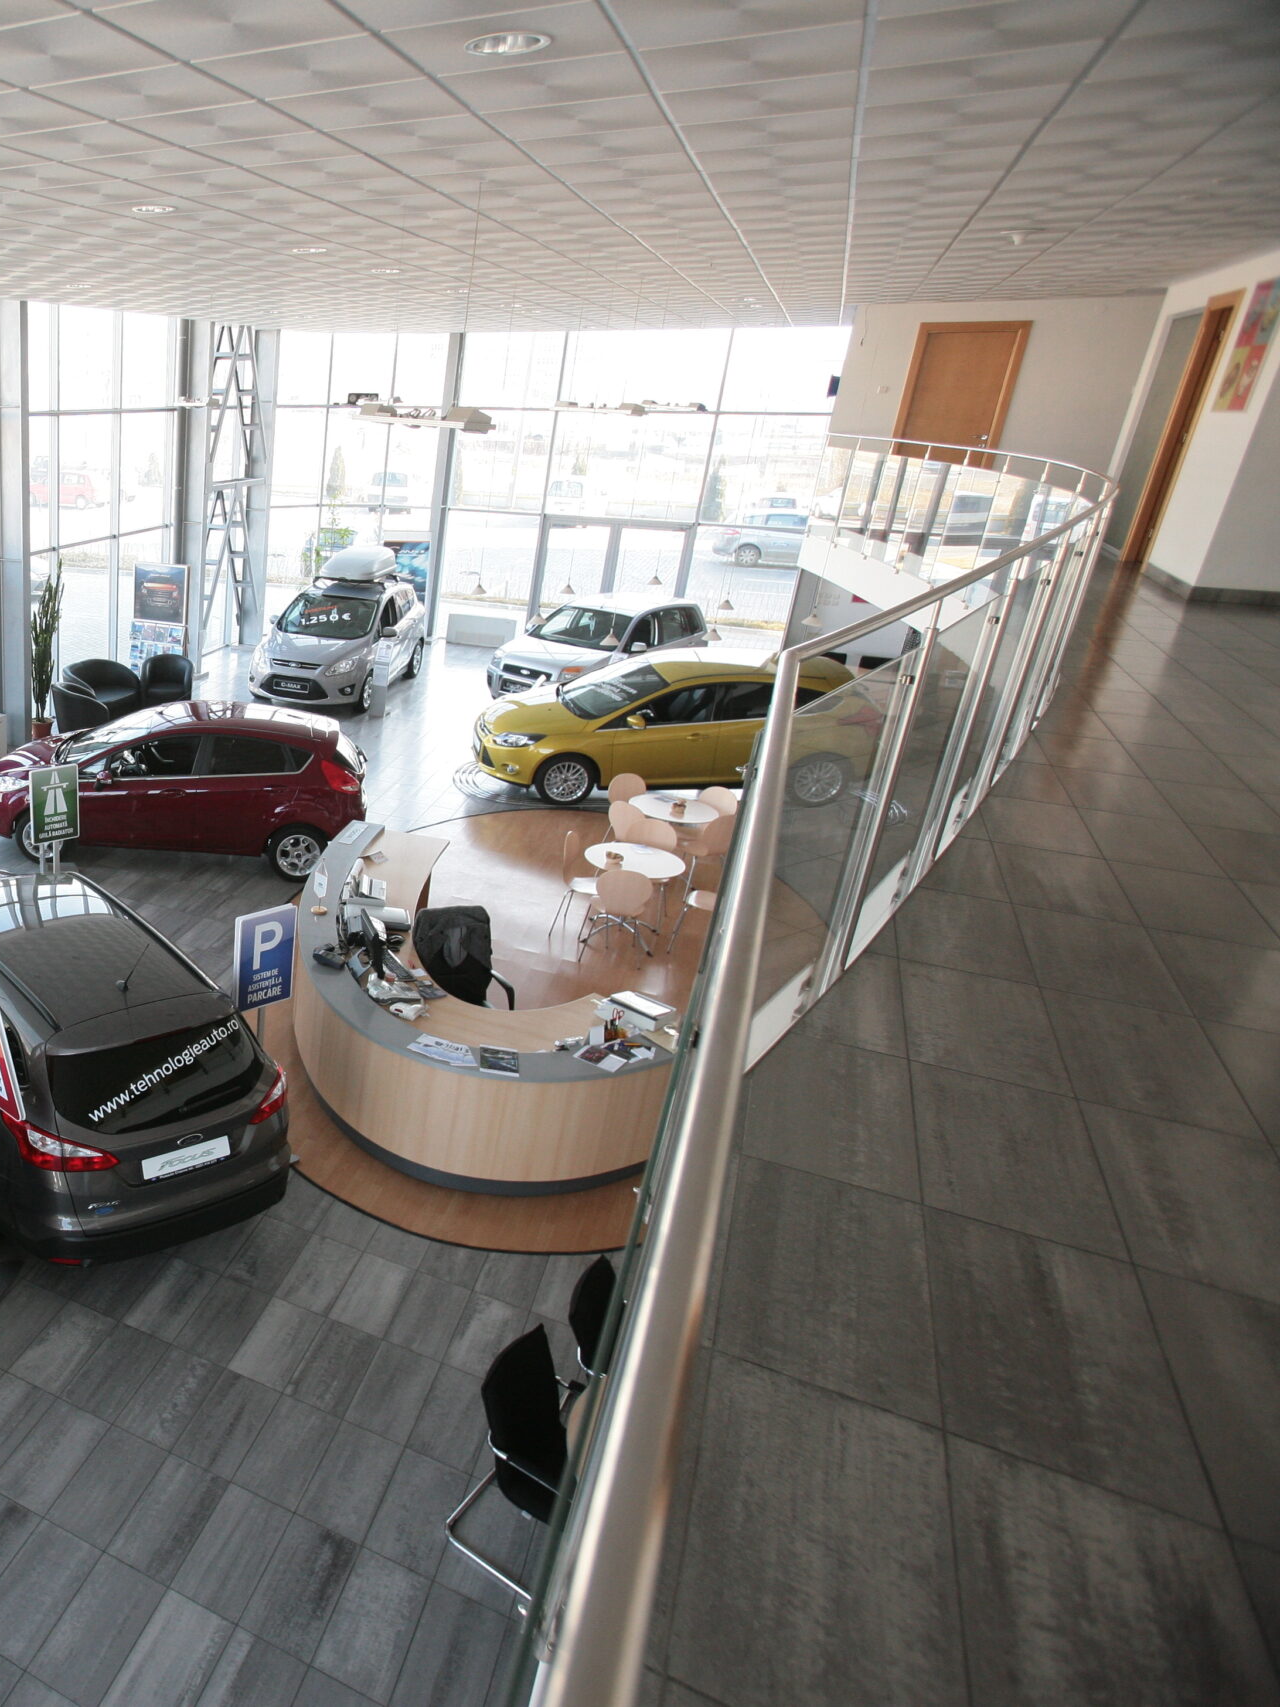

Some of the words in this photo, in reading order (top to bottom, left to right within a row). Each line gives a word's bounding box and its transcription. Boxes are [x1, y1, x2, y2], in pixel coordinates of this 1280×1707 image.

[252, 920, 283, 970] P
[253, 969, 271, 982] SISTEM
[271, 968, 279, 976] DE
[275, 976, 282, 984] LA
[247, 985, 282, 1004] PARCARE
[88, 1019, 239, 1122] www.tehnologieauto.ro
